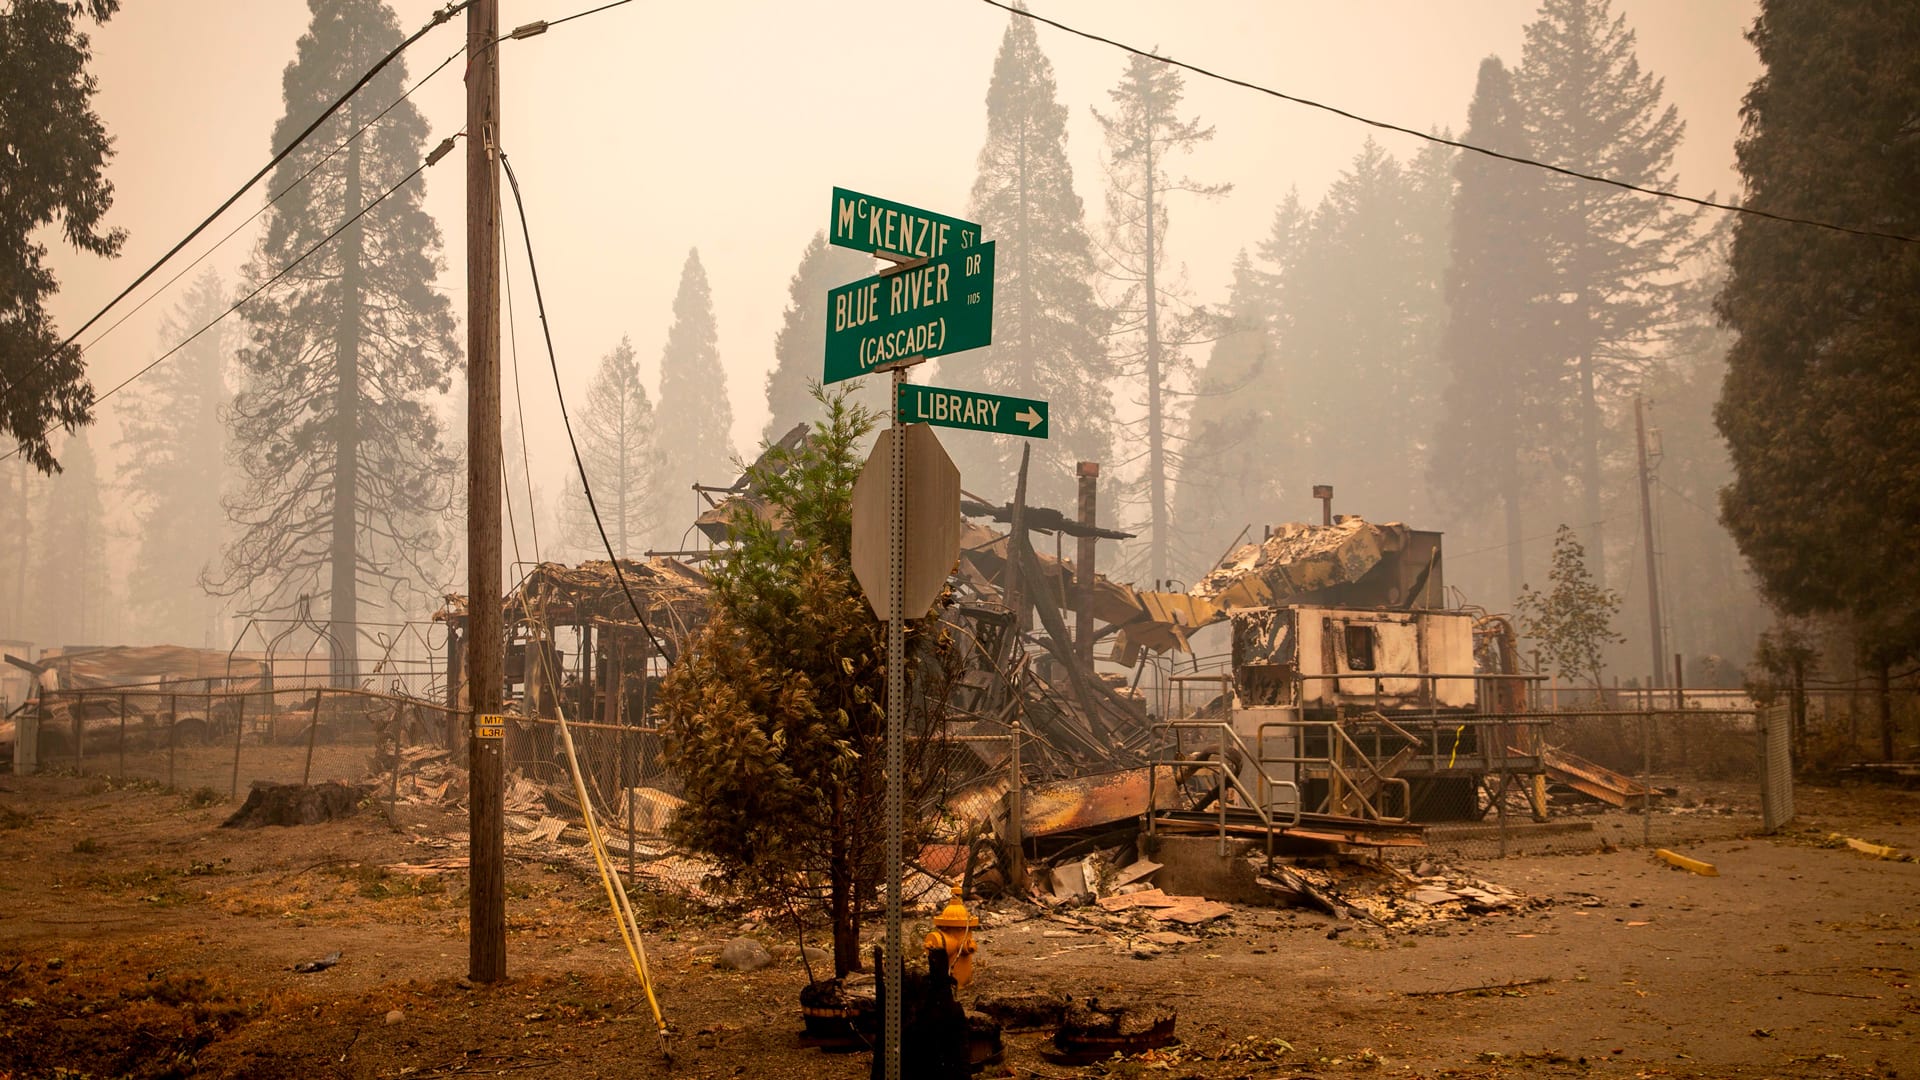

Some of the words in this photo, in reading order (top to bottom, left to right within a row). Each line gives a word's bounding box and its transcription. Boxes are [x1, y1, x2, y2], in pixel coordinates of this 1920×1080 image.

[961, 229, 975, 249] ST
[835, 282, 880, 332] BLUE
[890, 263, 950, 316] RIVER
[966, 254, 981, 277] DR
[859, 317, 946, 369] (CASCADE)
[917, 391, 1001, 426] LIBRARY
